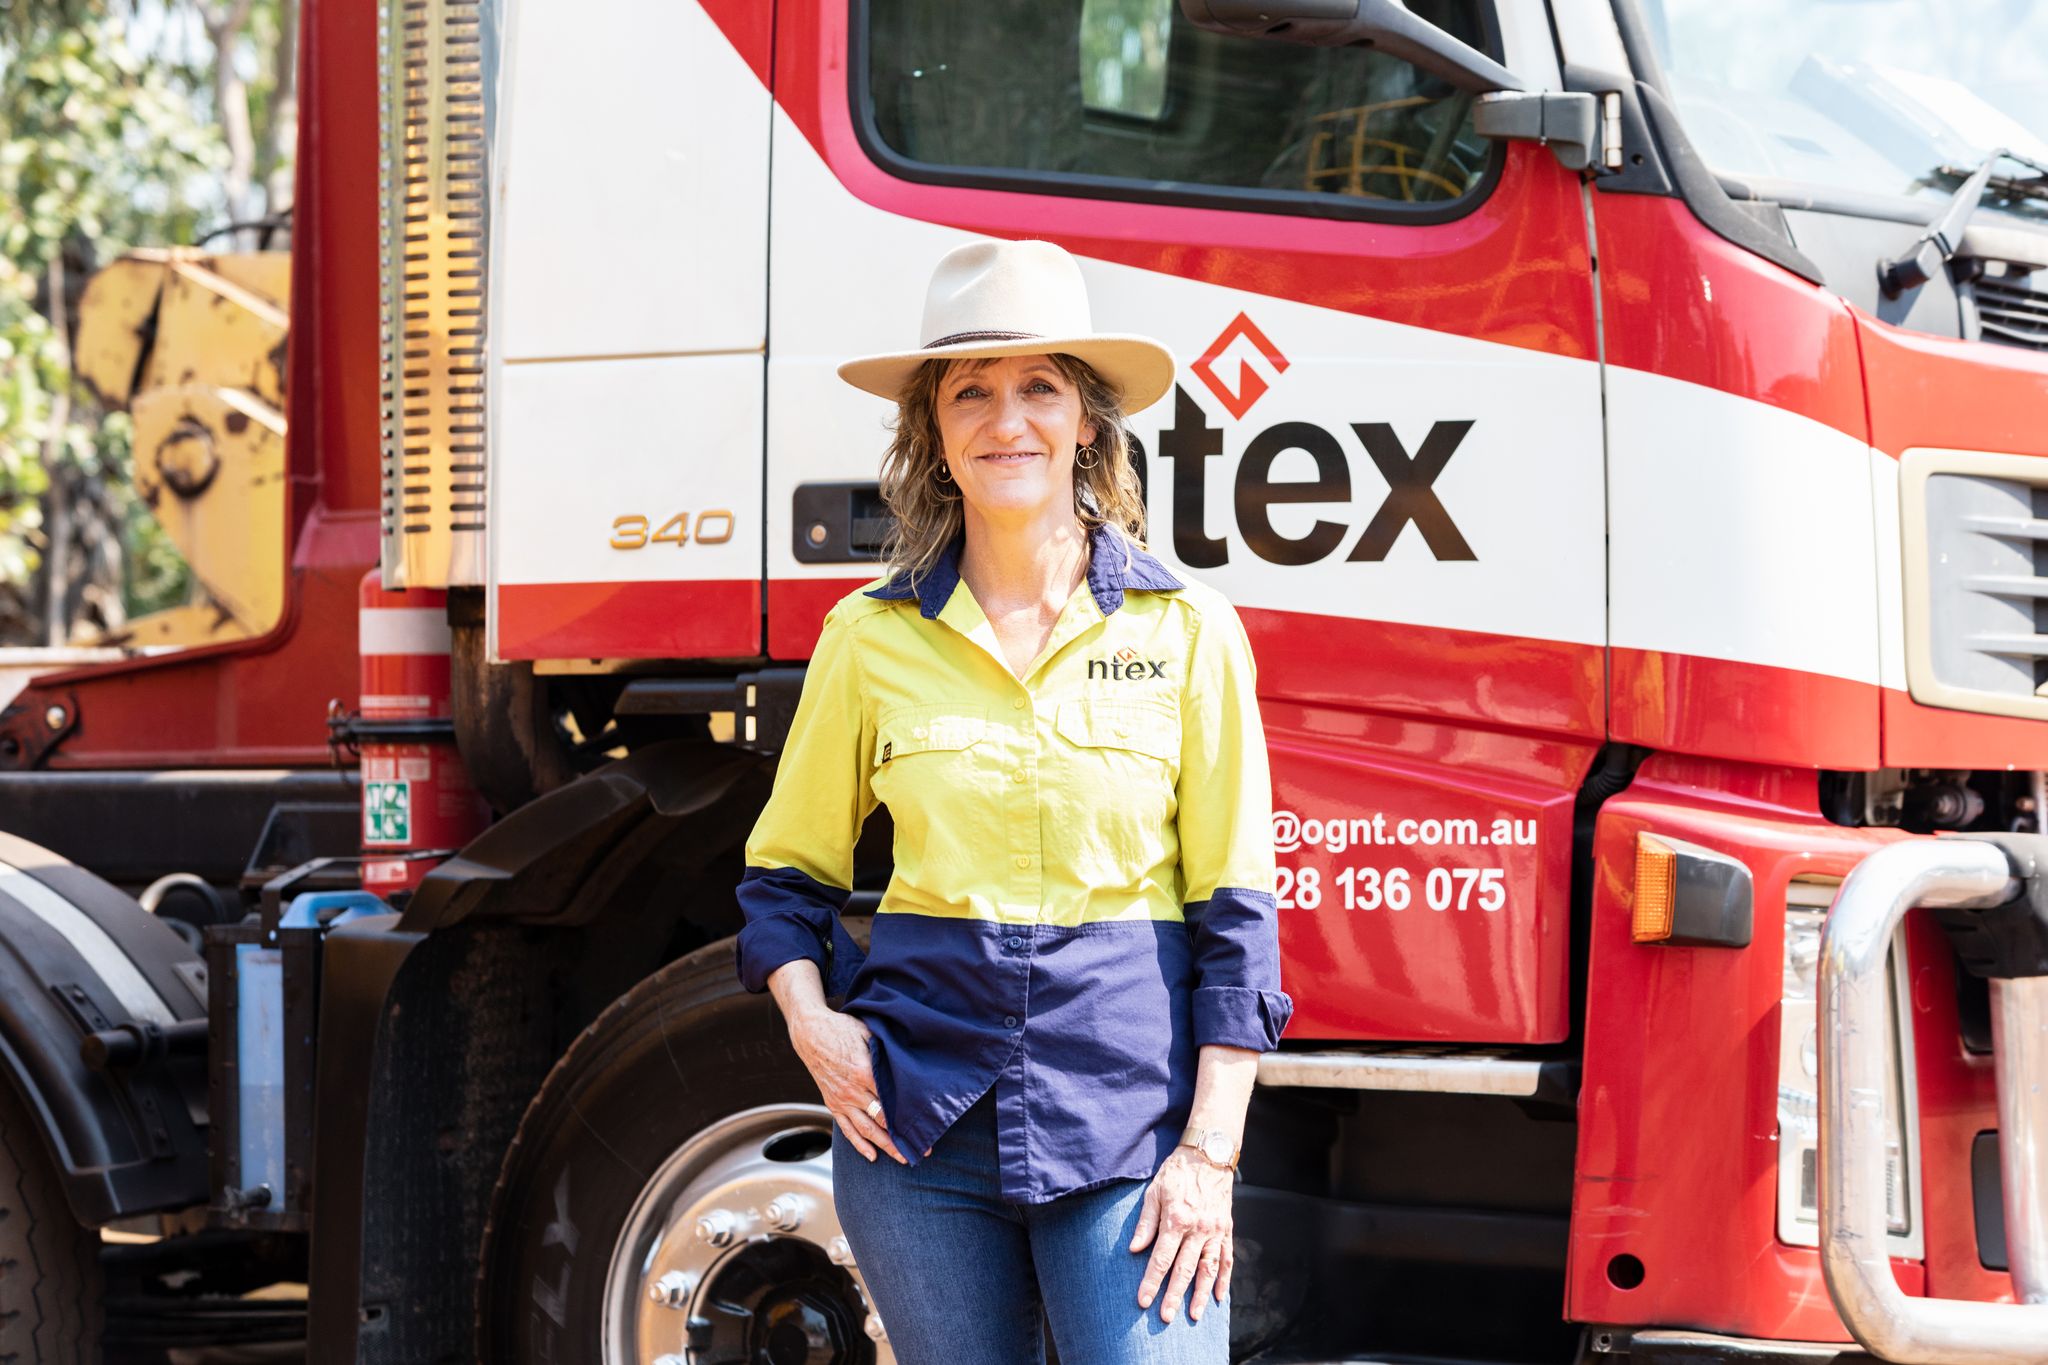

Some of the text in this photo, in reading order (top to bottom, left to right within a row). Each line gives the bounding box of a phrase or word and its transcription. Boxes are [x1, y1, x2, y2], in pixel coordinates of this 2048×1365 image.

[1125, 381, 1480, 569] tex
[610, 510, 735, 550] 340
[1087, 655, 1168, 681] ntex
[1272, 810, 1537, 853] @ognt.com.au
[1276, 866, 1506, 912] 28 136 075
